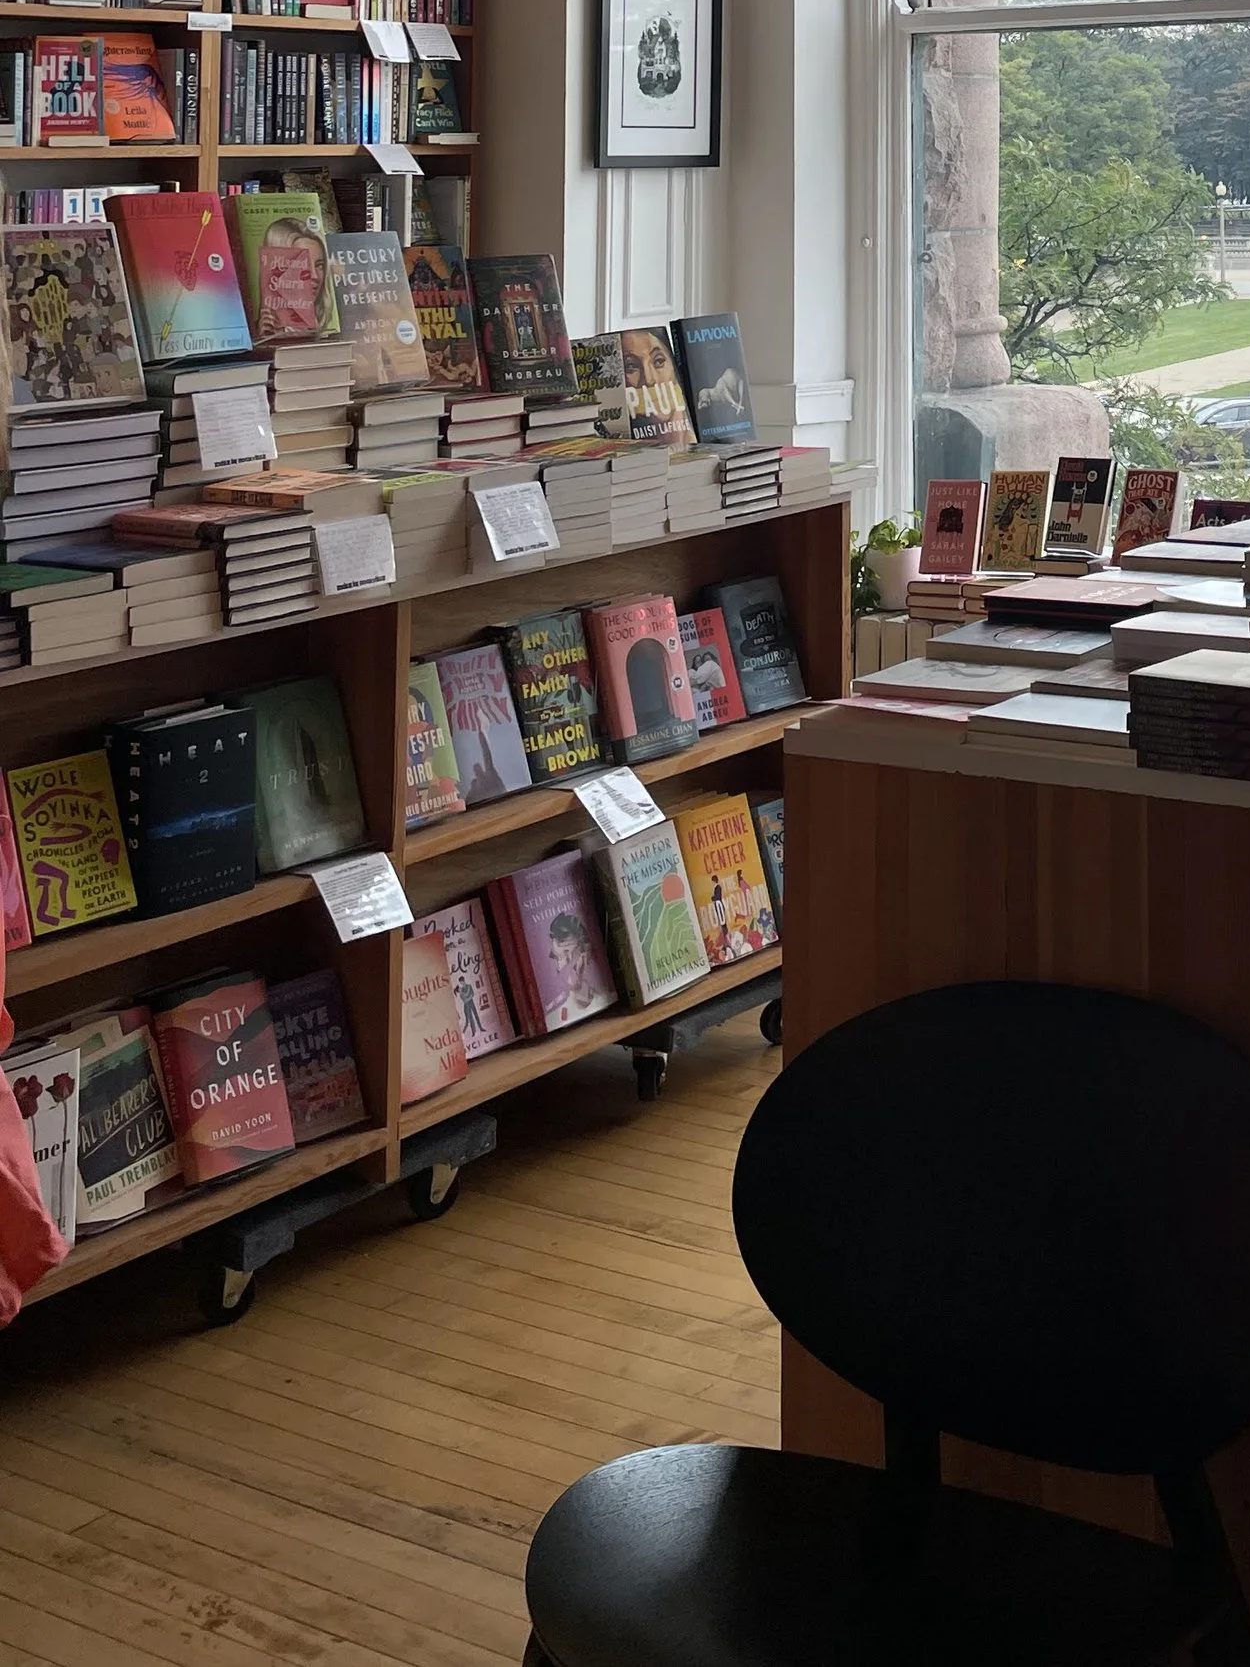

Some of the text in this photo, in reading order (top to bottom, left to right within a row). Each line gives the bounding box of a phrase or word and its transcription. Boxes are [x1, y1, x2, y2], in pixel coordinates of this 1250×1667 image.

[41, 54, 96, 82] HELL
[55, 82, 82, 91] OF A
[41, 91, 97, 118] BOOK
[324, 100, 332, 130] PENNY
[415, 118, 436, 128] Can't
[69, 198, 78, 214] 1
[92, 197, 100, 214] 1
[334, 269, 399, 287] PICTURES
[504, 283, 531, 292] THE
[342, 290, 399, 306] PRESENTS
[418, 306, 456, 323] ITHU
[483, 303, 559, 316] DAUGHTER
[420, 322, 467, 339] NYAL
[518, 326, 533, 335] OF
[686, 325, 737, 344] LAPVONA
[155, 335, 179, 354] Tess
[502, 346, 557, 359] DOCTOR
[505, 368, 563, 381] MOREAU
[625, 380, 686, 419] PAUL
[632, 424, 658, 440] DAISY
[994, 474, 1046, 484] HUMAN
[1128, 474, 1174, 492] GHOST
[930, 486, 978, 496] JUST LIKE
[938, 500, 968, 508] HOME
[1048, 520, 1072, 532] John
[1196, 513, 1225, 528] Acts
[930, 542, 965, 550] SARAH
[928, 555, 964, 564] GAILEY
[604, 615, 620, 628] THE
[522, 630, 549, 650] ANY
[607, 626, 636, 643] GOOD
[542, 646, 588, 669] OTHER
[522, 673, 570, 699] FAMILY
[696, 694, 729, 711] ANDREA
[672, 722, 694, 736] CHAN
[524, 724, 585, 753] ELEANOR
[158, 732, 248, 767] HEAT
[547, 744, 600, 772] BROWN
[199, 770, 208, 783] 2
[269, 754, 344, 790] TRUST
[406, 762, 434, 786] BIRD
[13, 770, 78, 799] WOLE
[128, 742, 141, 826] HEAT
[23, 798, 112, 843] SOYINKA
[688, 813, 748, 852] KATHERINE
[26, 826, 114, 862] CHRONICLES FROM
[128, 838, 139, 849] 2
[652, 837, 672, 855] FOR
[71, 853, 98, 868] LAND
[703, 842, 746, 874] CENTER
[74, 868, 120, 889] HAPPIEST
[620, 854, 680, 888] THE MISSING
[82, 882, 116, 900] PEOPLE
[97, 890, 127, 907] EARTH
[450, 951, 486, 975] eling
[656, 946, 690, 969] BELINDA
[684, 956, 706, 974] TANG
[402, 974, 450, 1004] oughts
[200, 1004, 246, 1036] CITY
[278, 1025, 342, 1060] ALLING
[424, 1028, 460, 1054] Nada
[483, 1032, 499, 1045] LEE
[216, 1040, 242, 1066] OF
[190, 1063, 278, 1110] ORANGE
[124, 1109, 165, 1158] CLUB
[212, 1112, 272, 1141] DAVID YOON
[86, 1146, 177, 1206] PAUL TREMBLAY
